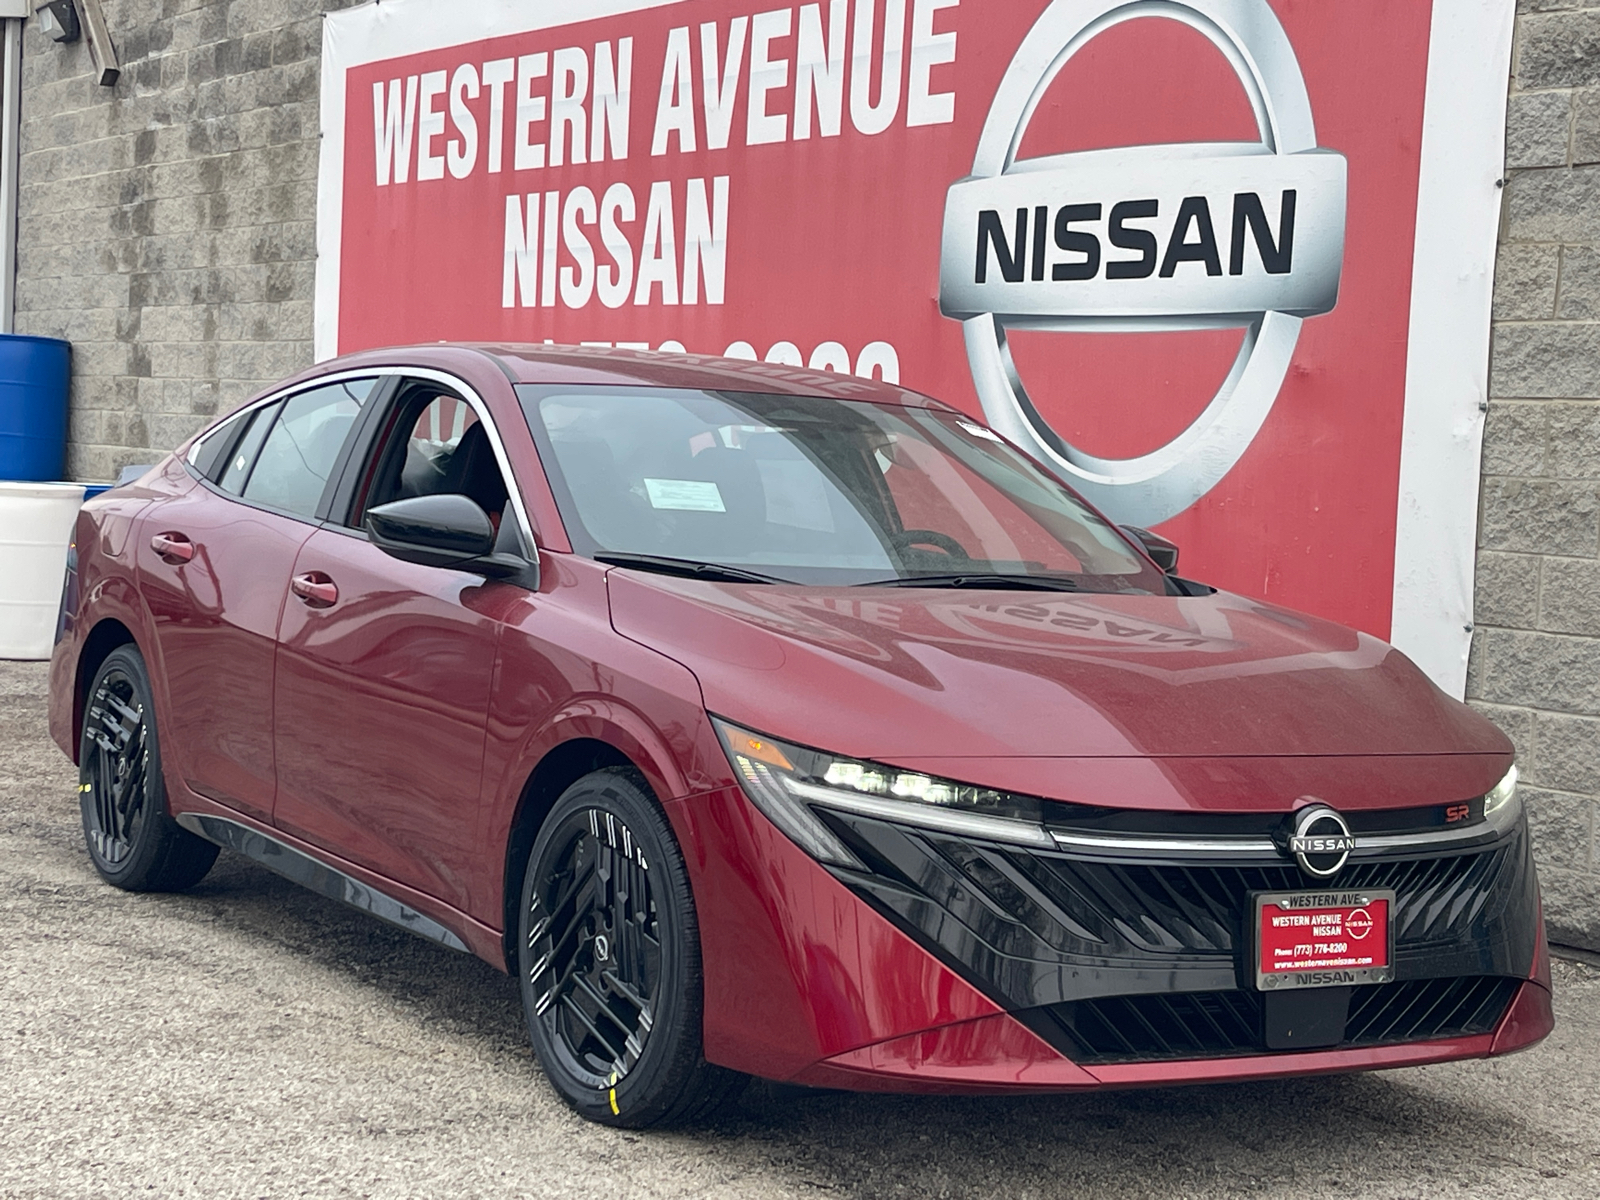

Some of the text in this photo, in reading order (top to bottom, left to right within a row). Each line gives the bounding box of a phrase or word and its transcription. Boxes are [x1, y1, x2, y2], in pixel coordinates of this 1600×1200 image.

[372, 0, 961, 187] WESTERN AVENUE
[500, 175, 731, 310] NISSAN
[974, 188, 1298, 284] NISSAN
[1446, 805, 1469, 821] SR
[1293, 838, 1355, 850] NISSAN
[1290, 894, 1338, 908] WESTERN
[1272, 914, 1342, 927] WESTERN AVENUE
[1313, 926, 1342, 937] NISSAN
[1294, 944, 1313, 957] (773)
[1314, 942, 1348, 954] 776-8200
[1296, 971, 1355, 985] NISSAN
